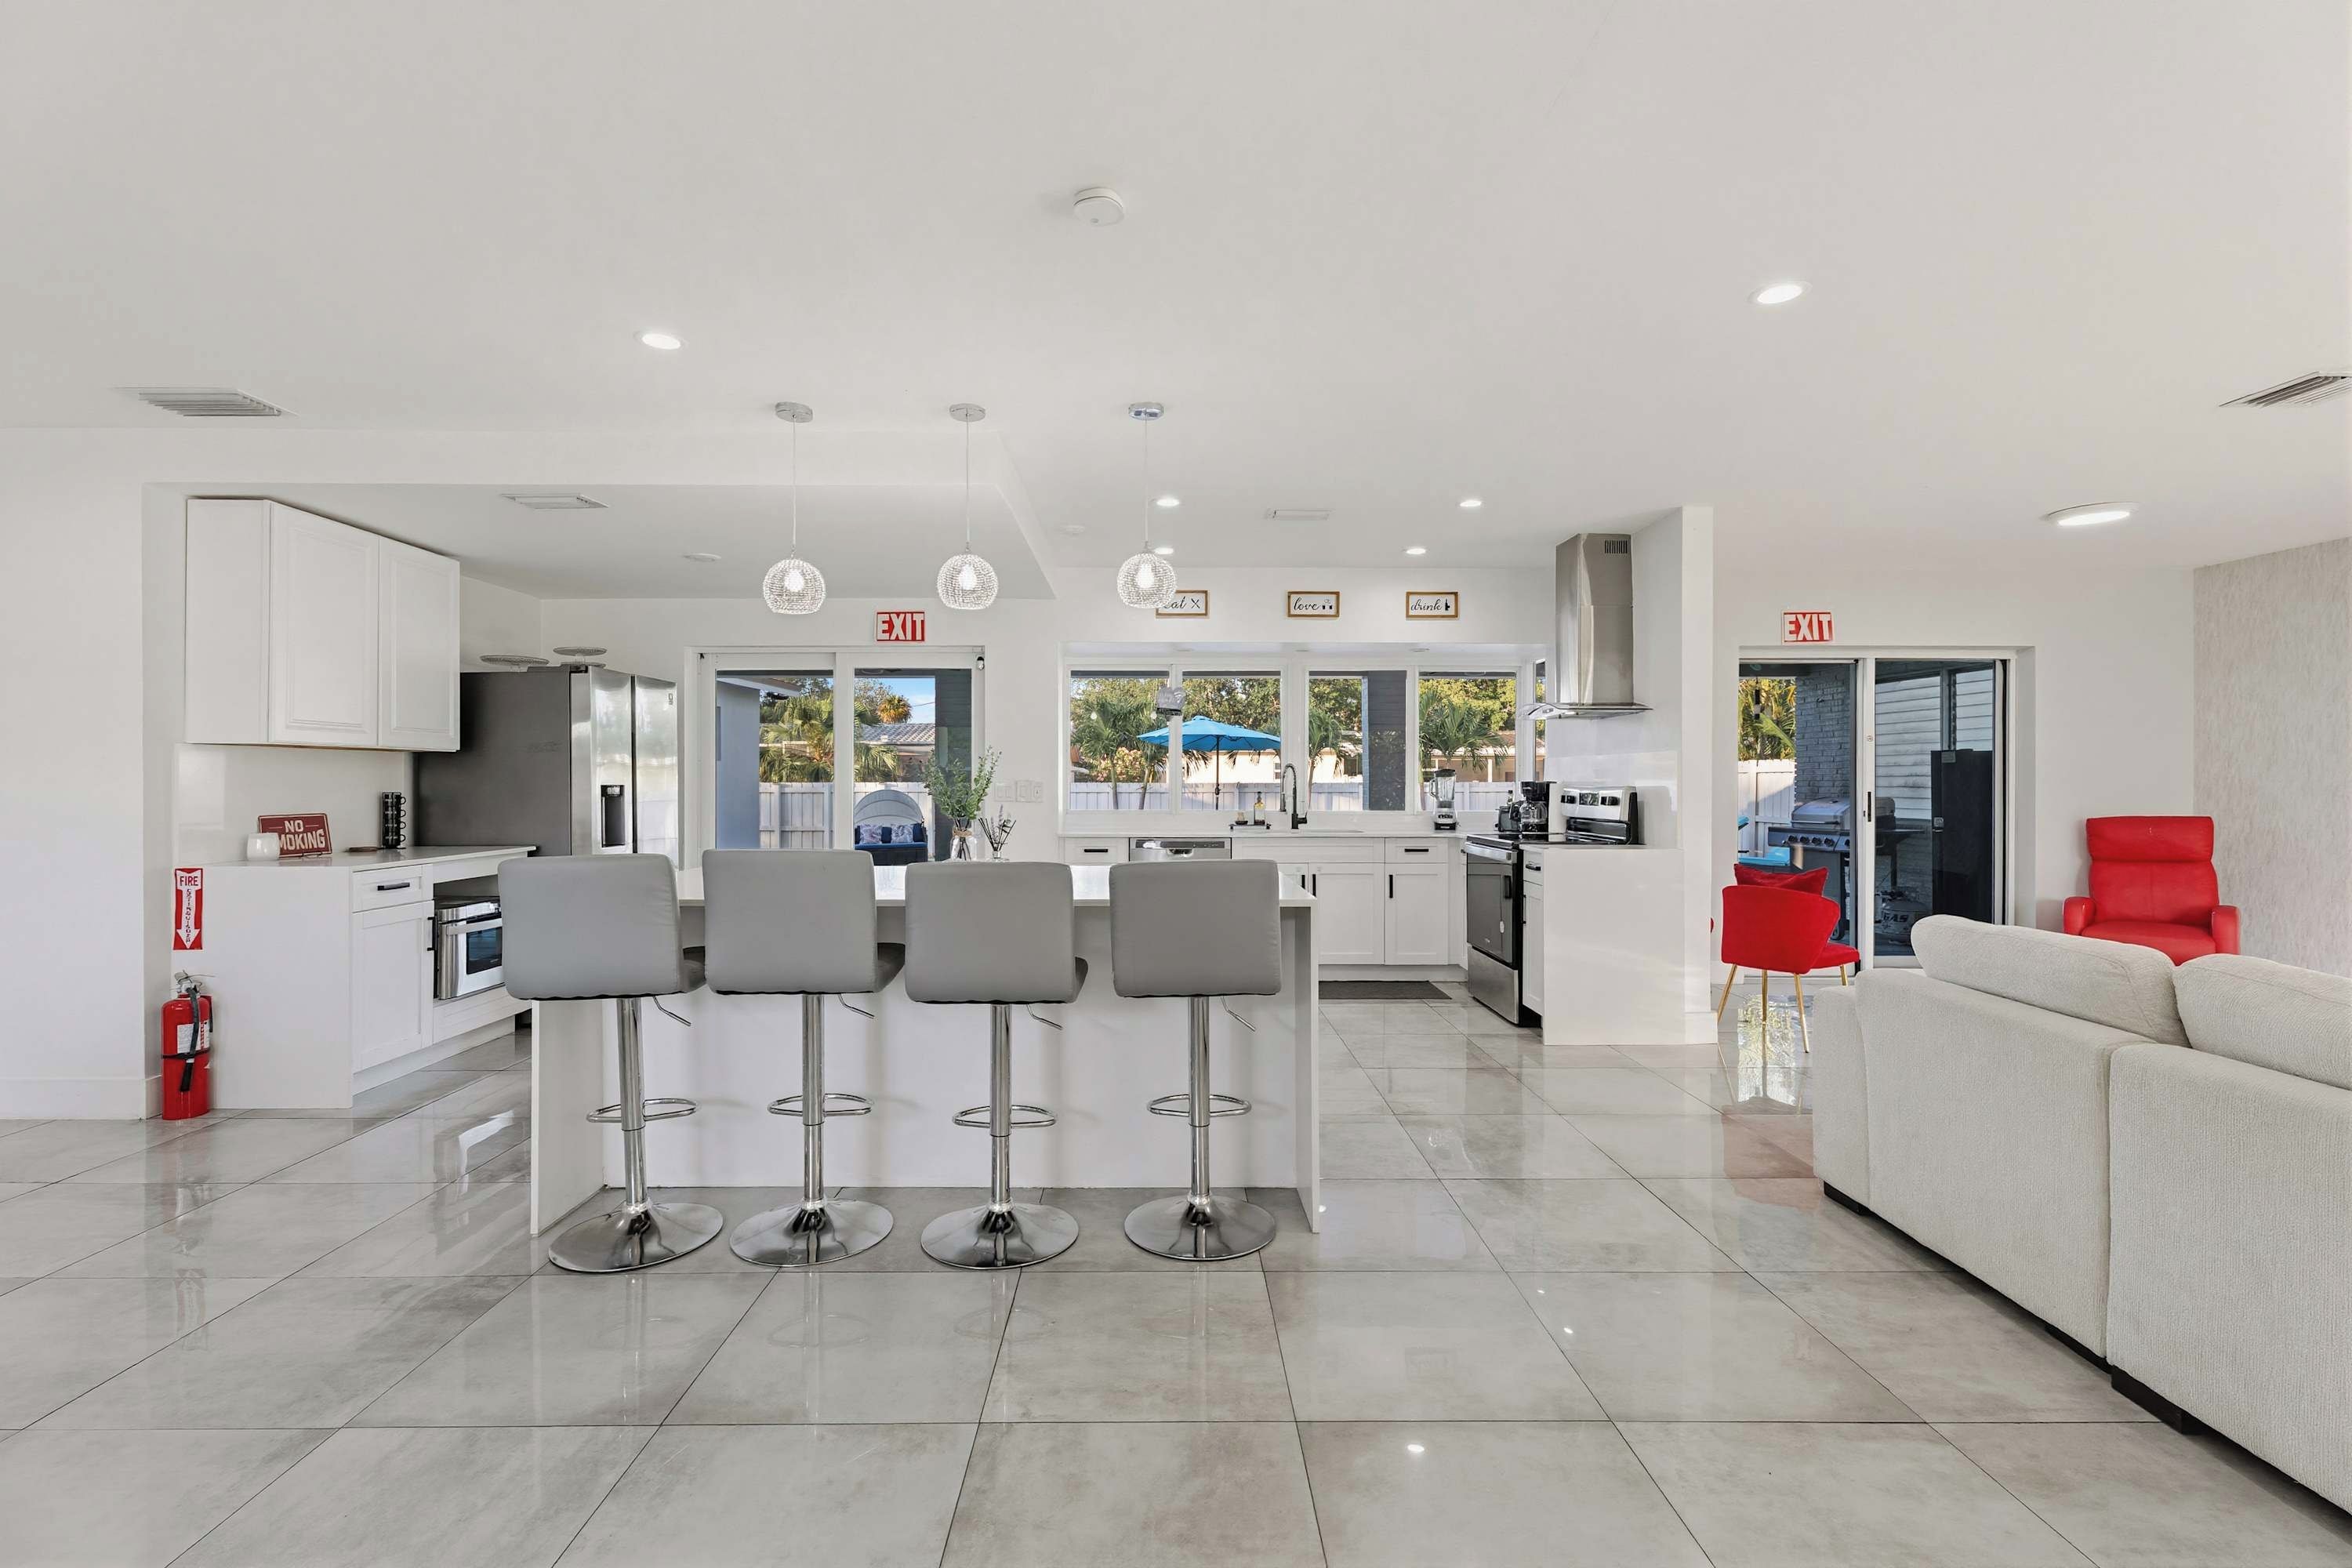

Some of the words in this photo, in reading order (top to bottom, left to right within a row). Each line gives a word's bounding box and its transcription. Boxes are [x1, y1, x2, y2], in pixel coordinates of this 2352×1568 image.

[1294, 597, 1322, 610] love
[1410, 598, 1443, 611] drink
[877, 613, 924, 641] EXIT
[1784, 614, 1832, 641] EXIT
[285, 819, 304, 833] NO
[279, 829, 325, 851] MOKING
[180, 876, 199, 886] FIRE
